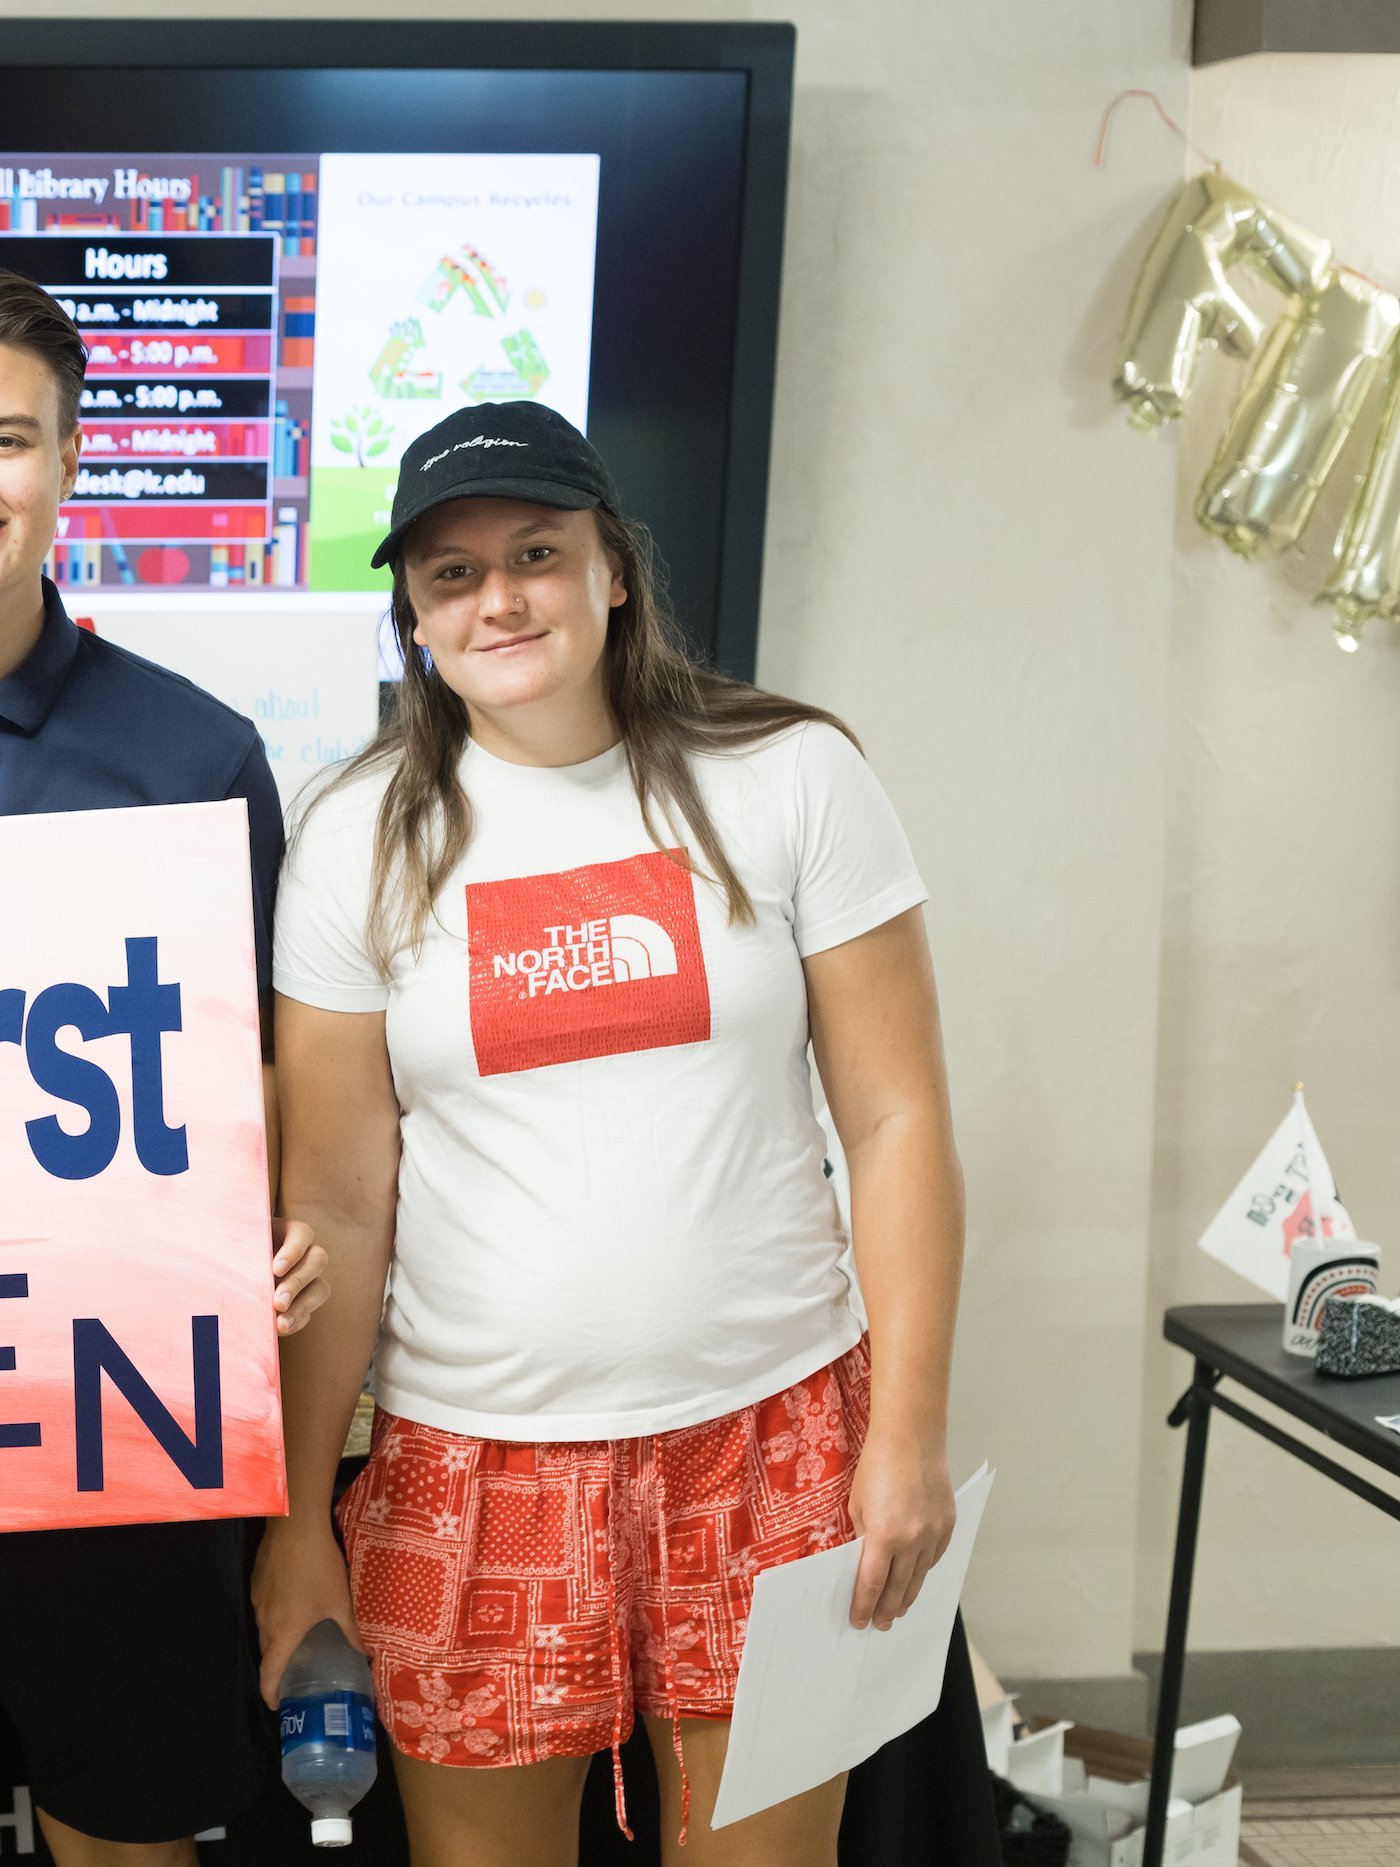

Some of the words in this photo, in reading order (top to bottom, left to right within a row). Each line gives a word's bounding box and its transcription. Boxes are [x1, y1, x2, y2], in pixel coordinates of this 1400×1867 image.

[17, 168, 109, 204] Library
[113, 168, 192, 199] Hours
[401, 192, 481, 209] Campus
[487, 190, 572, 210] Recycles
[84, 247, 168, 280] Hours
[76, 303, 120, 322] a.m.
[133, 298, 219, 326] Midnight
[131, 341, 173, 364] 5:00
[174, 345, 218, 367] p.m.
[135, 385, 178, 408] 5:00
[178, 390, 222, 412] p.m.
[131, 429, 216, 455] Midnight
[543, 918, 608, 947] THE
[493, 938, 611, 979] NORTH
[526, 961, 613, 998] FACE
